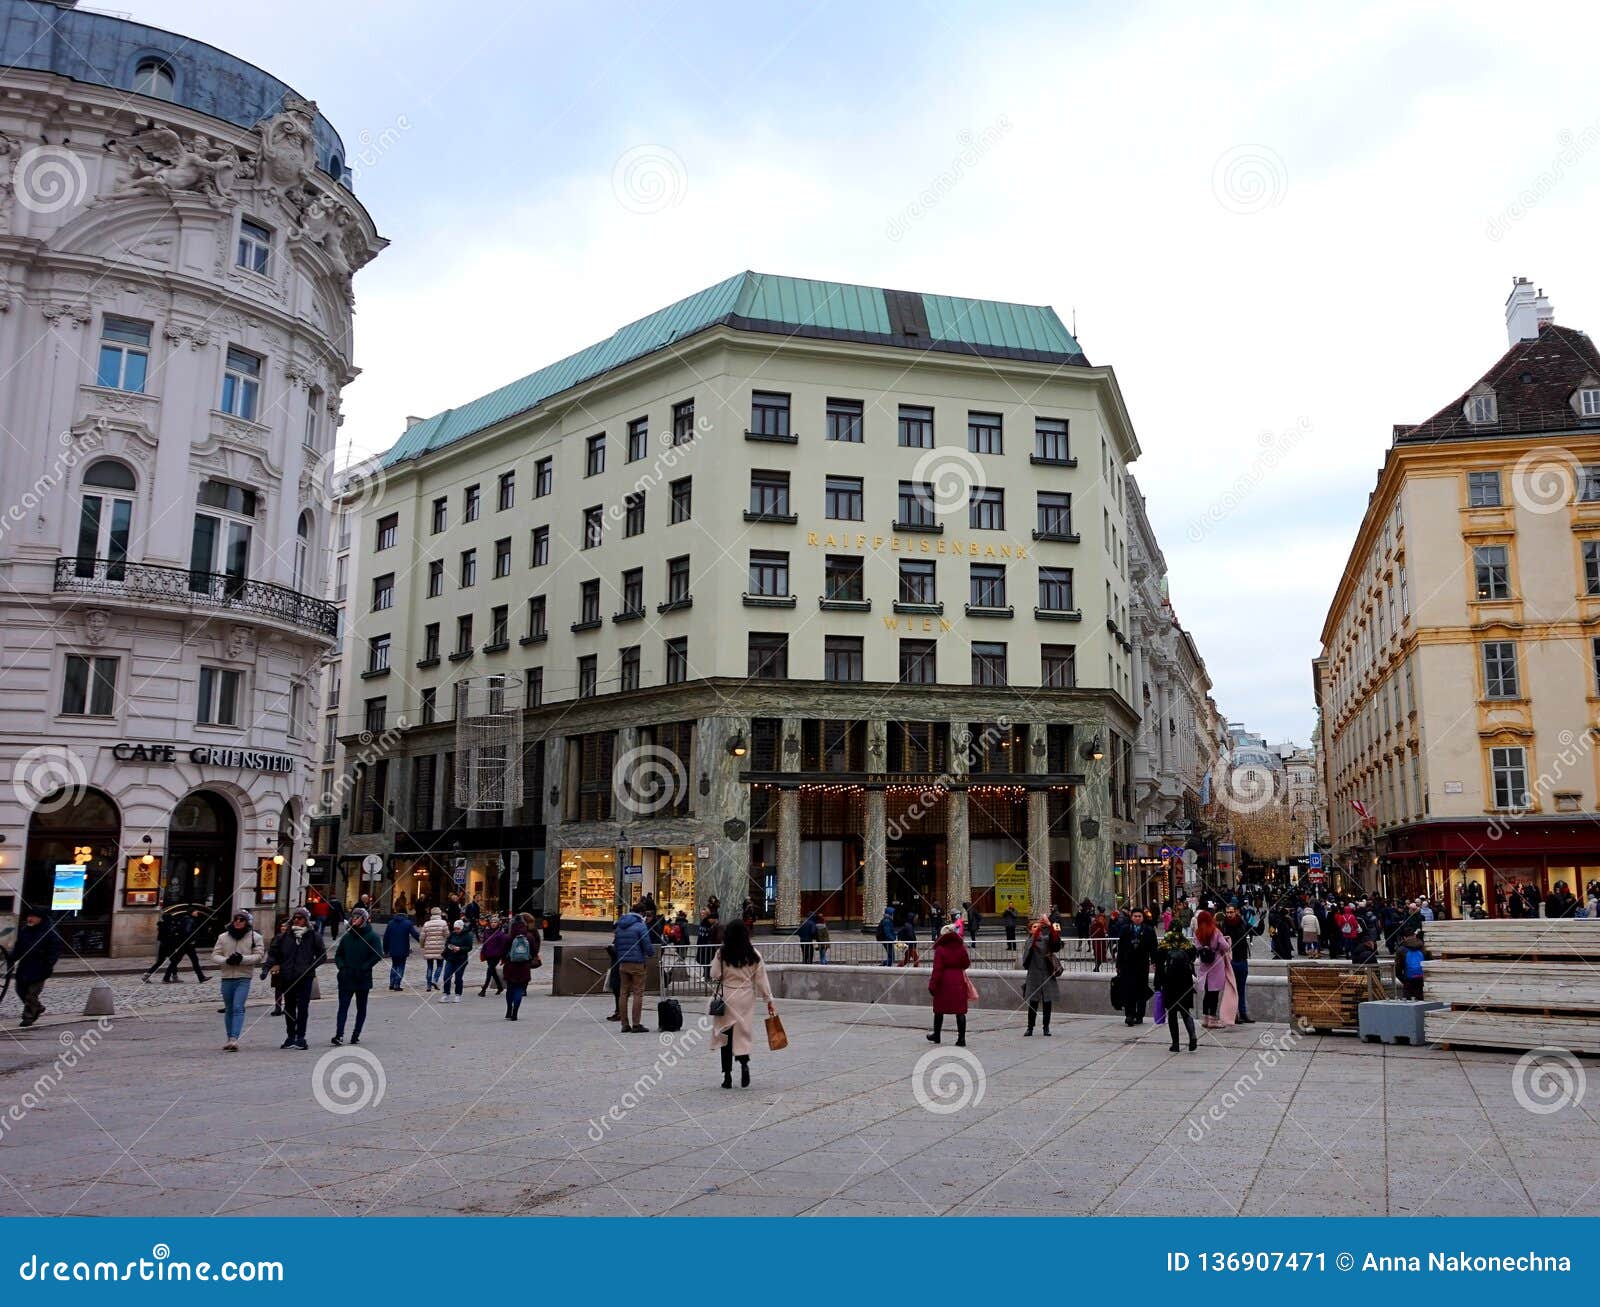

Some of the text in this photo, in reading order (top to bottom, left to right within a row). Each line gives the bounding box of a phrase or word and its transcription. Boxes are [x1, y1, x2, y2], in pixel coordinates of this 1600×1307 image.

[807, 532, 1027, 559] RAIFFEISENBANK
[884, 615, 950, 632] WIEN
[112, 743, 176, 762] CAFE
